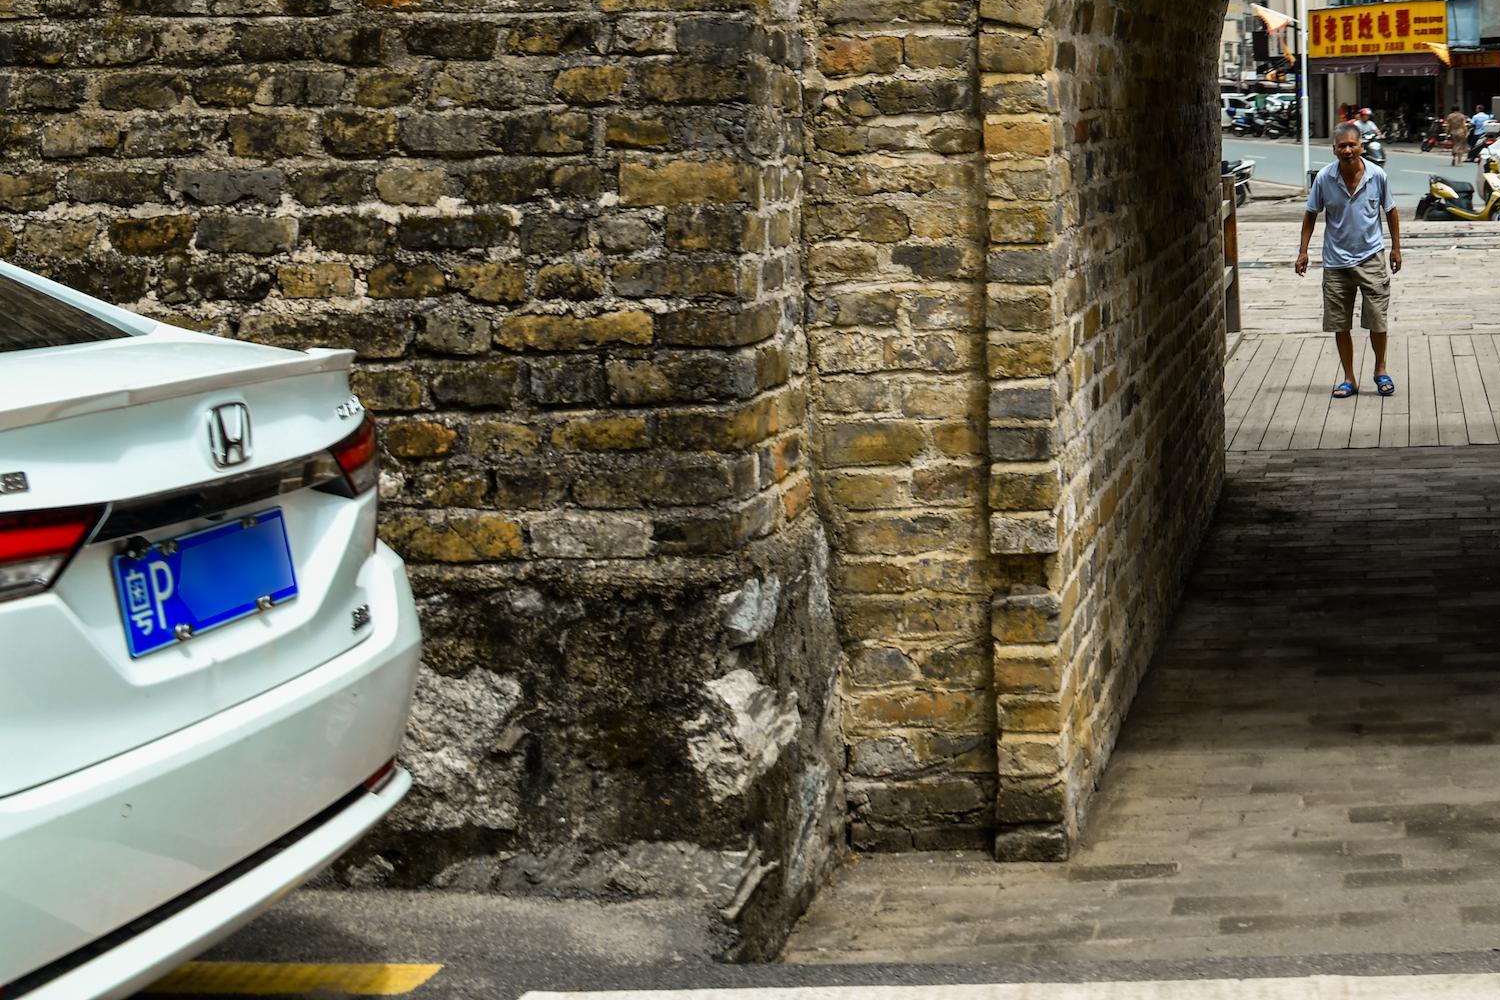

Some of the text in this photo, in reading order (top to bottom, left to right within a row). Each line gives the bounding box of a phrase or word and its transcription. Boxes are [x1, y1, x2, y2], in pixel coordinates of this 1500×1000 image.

[1324, 9, 1410, 42] 老百姓电器
[125, 560, 174, 635] 粤P
